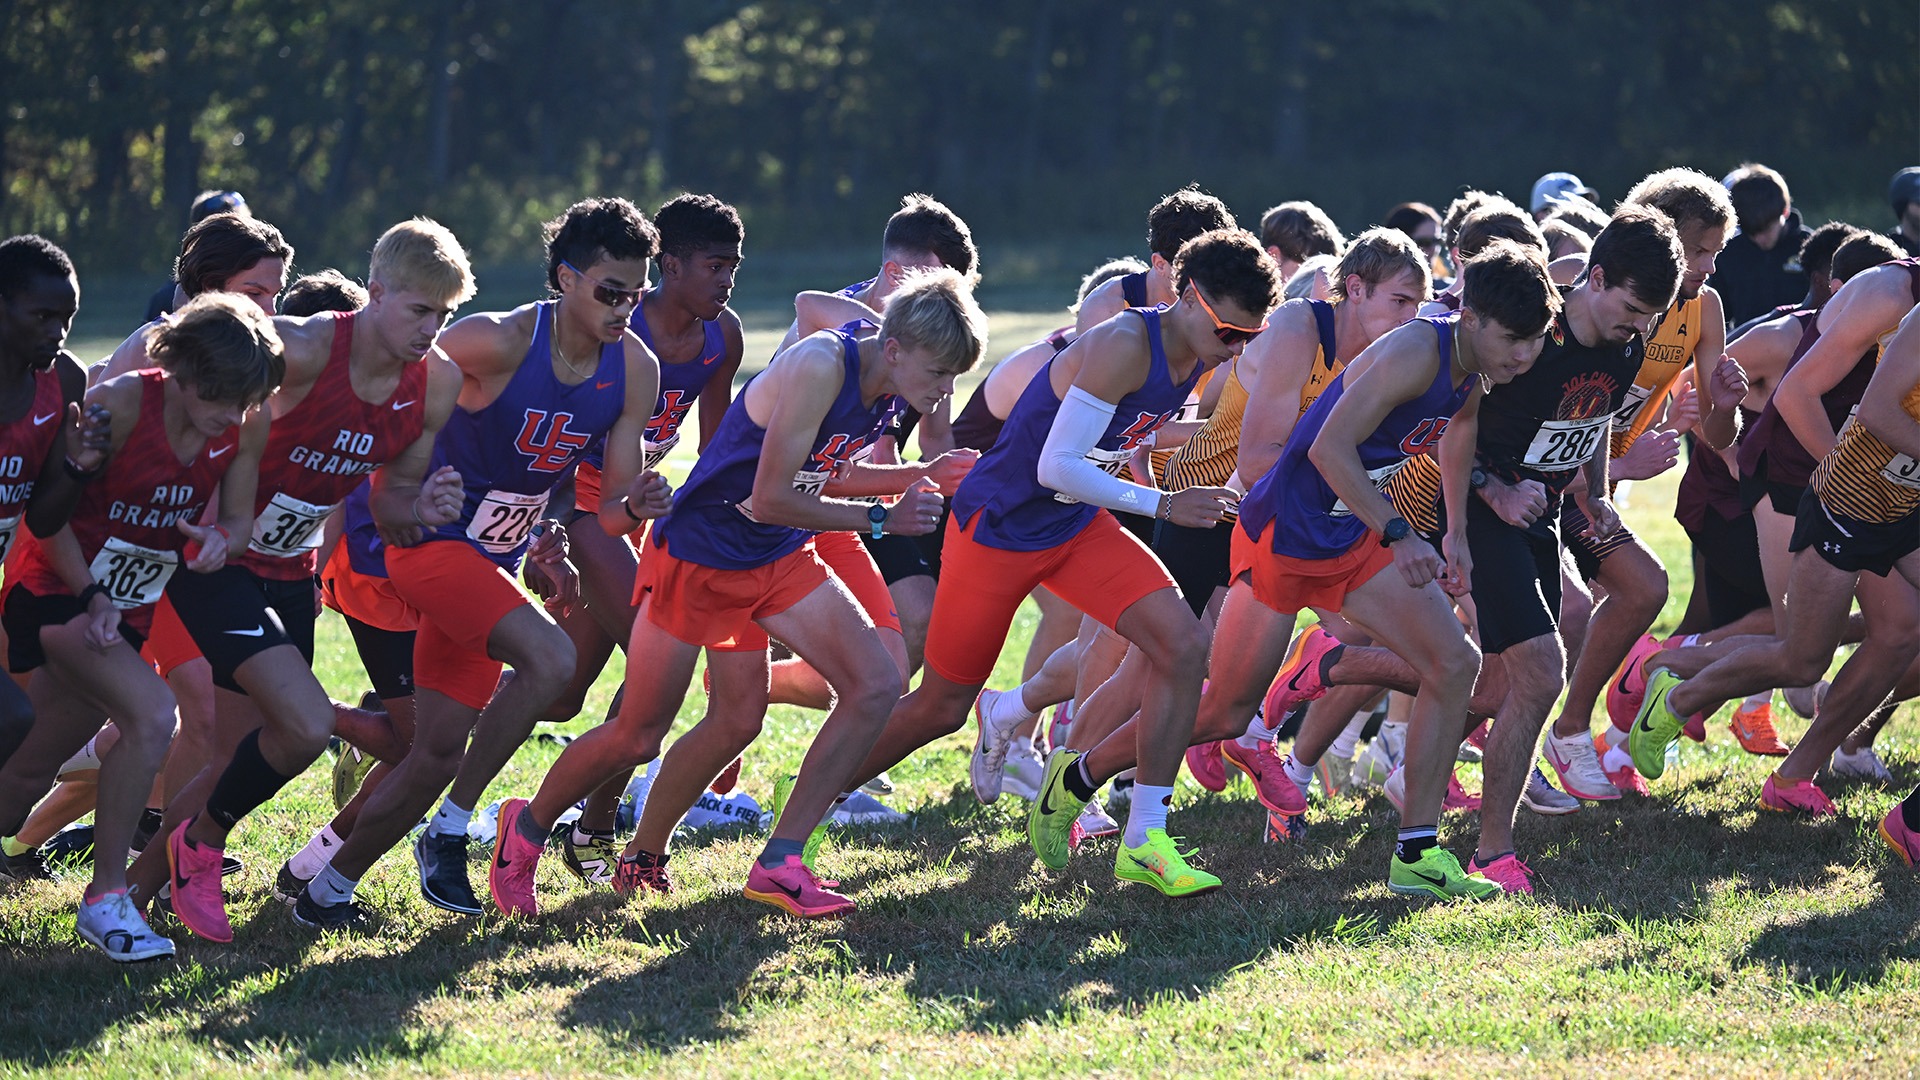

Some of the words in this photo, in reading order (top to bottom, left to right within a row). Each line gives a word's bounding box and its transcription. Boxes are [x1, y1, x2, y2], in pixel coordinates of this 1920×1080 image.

[1643, 341, 1685, 364] OMB
[1562, 372, 1587, 397] JOE
[1590, 371, 1620, 394] CHILI
[1613, 400, 1645, 426] 4
[332, 429, 374, 455] RIO
[513, 407, 592, 473] UE
[1539, 426, 1600, 464] 286
[0, 456, 23, 478] IO
[150, 485, 194, 506] RIO
[262, 513, 322, 550] 36
[478, 506, 542, 543] 228
[99, 554, 164, 600] 362
[694, 796, 722, 812] ACK
[723, 803, 733, 816] &
